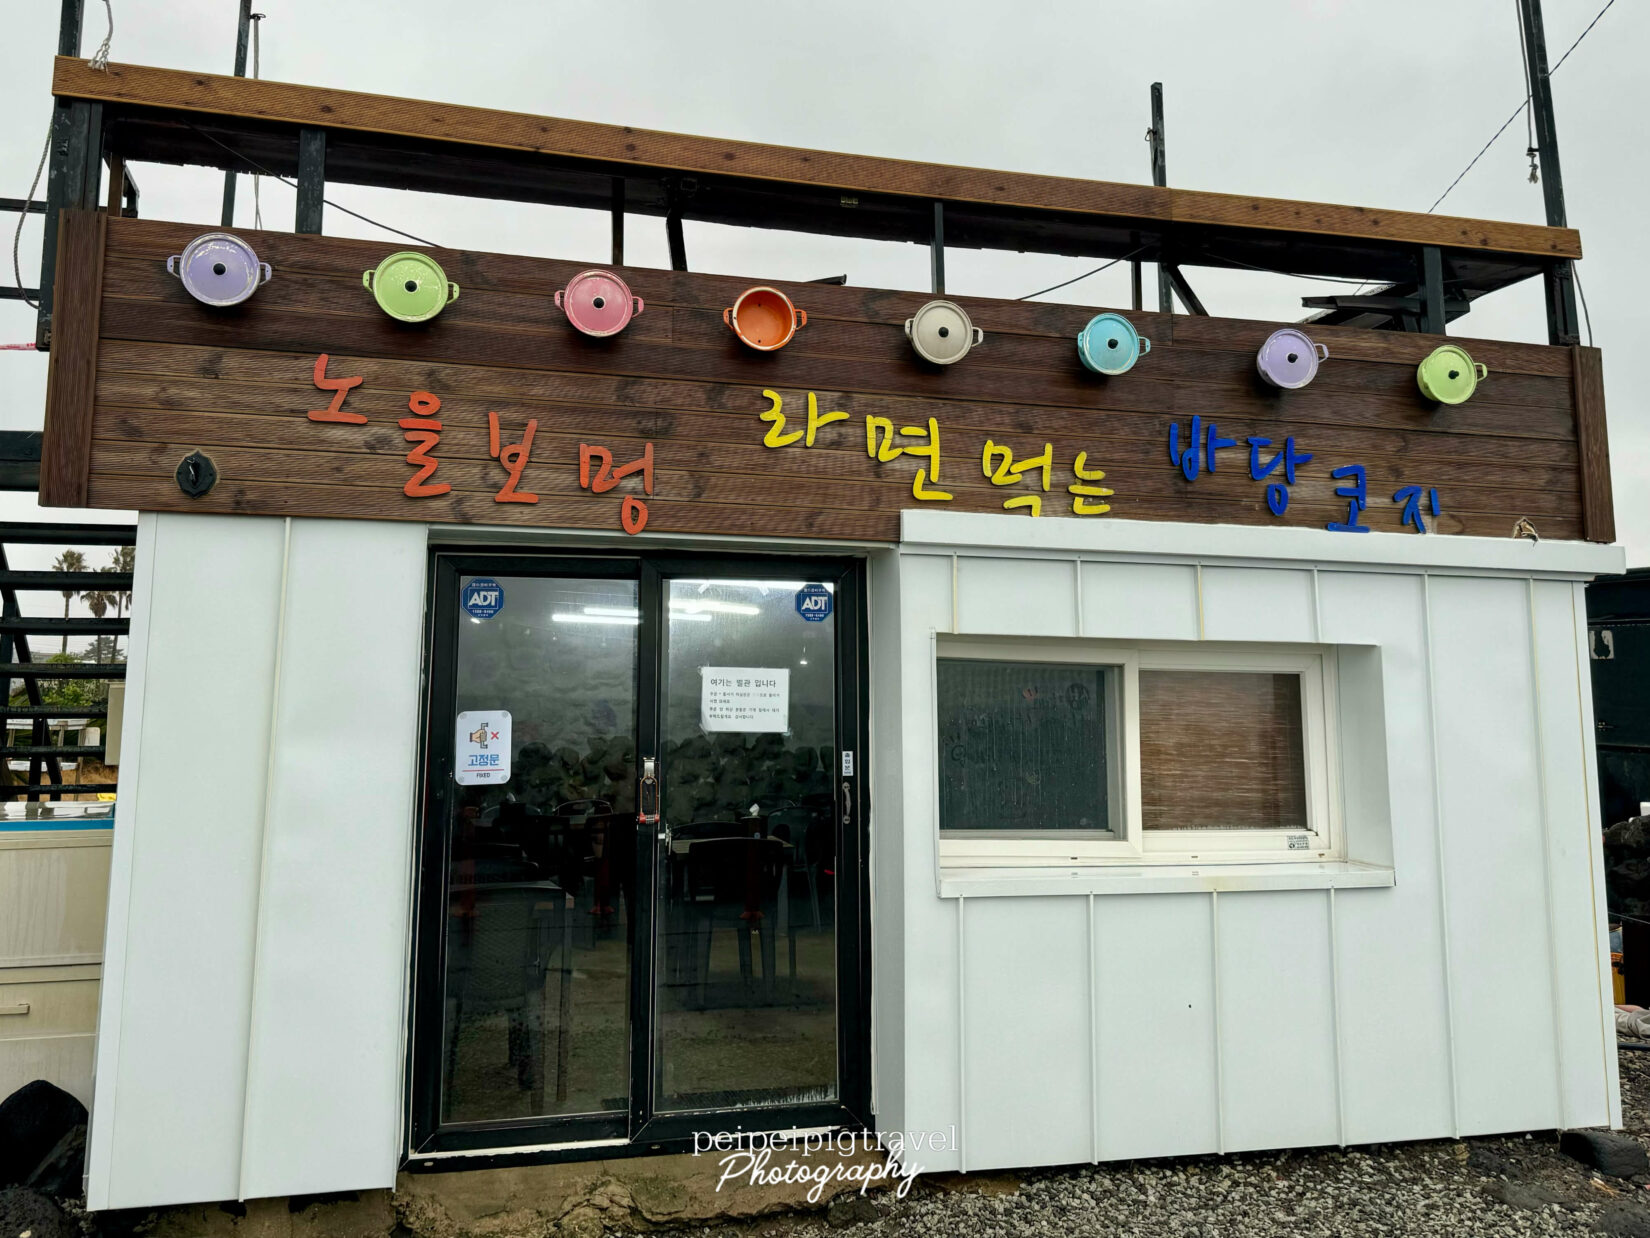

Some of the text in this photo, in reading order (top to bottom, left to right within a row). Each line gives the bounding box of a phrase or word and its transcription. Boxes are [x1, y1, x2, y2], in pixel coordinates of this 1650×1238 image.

[468, 591, 499, 606] ADT
[801, 596, 828, 610] ADT
[710, 678, 732, 687] 여기는
[754, 679, 776, 688] 입니다
[468, 754, 499, 767] 고정문
